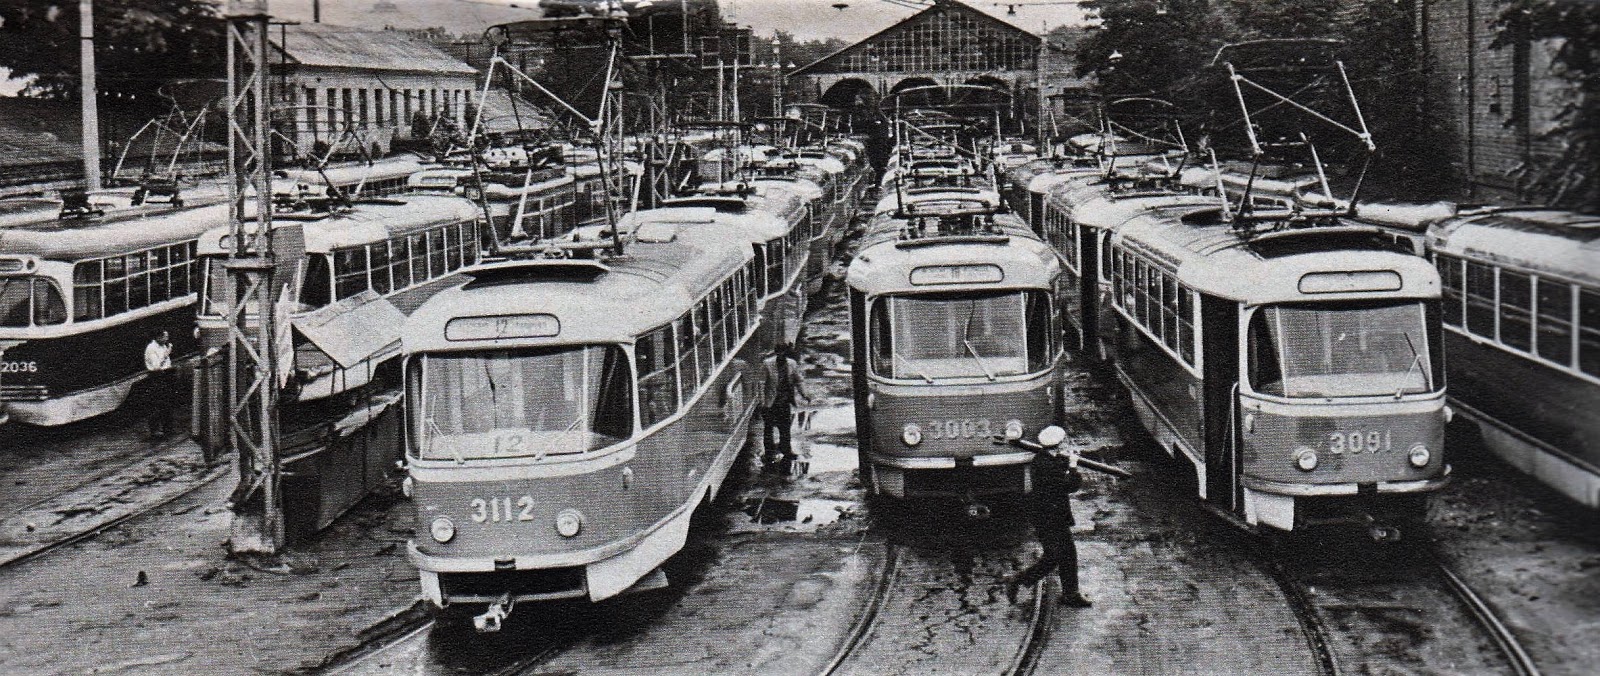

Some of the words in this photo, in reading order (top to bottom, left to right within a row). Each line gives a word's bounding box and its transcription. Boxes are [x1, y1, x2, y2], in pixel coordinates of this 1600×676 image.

[1, 361, 37, 372] 2036
[494, 435, 522, 453] 12
[1330, 430, 1391, 454] 3091
[470, 495, 535, 523] 3112
